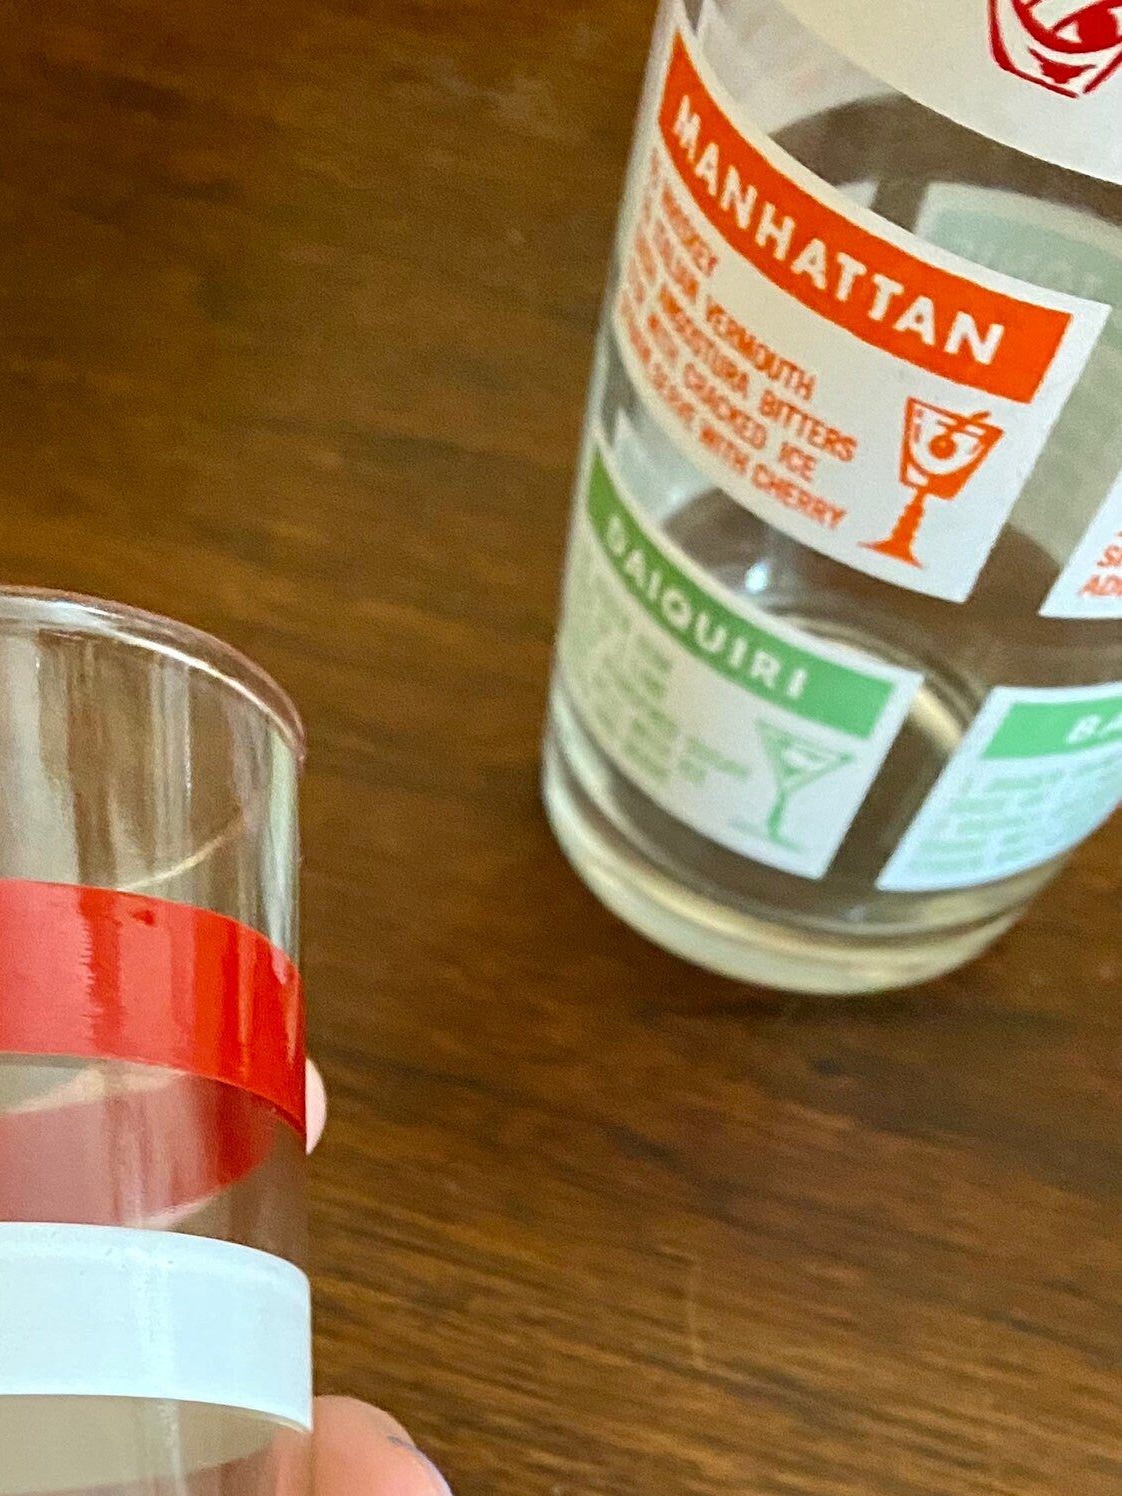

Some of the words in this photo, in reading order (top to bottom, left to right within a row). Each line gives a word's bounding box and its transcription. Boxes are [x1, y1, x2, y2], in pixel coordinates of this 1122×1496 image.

[673, 94, 1004, 366] MANHATTAN
[705, 300, 816, 400] VERMOUTH
[683, 363, 765, 449] CRACKED
[779, 443, 818, 483] ICE
[699, 424, 749, 472] WITH
[752, 464, 846, 529] CHERRY
[760, 390, 856, 461] BITTERS
[607, 514, 808, 700] DAIQUIRI
